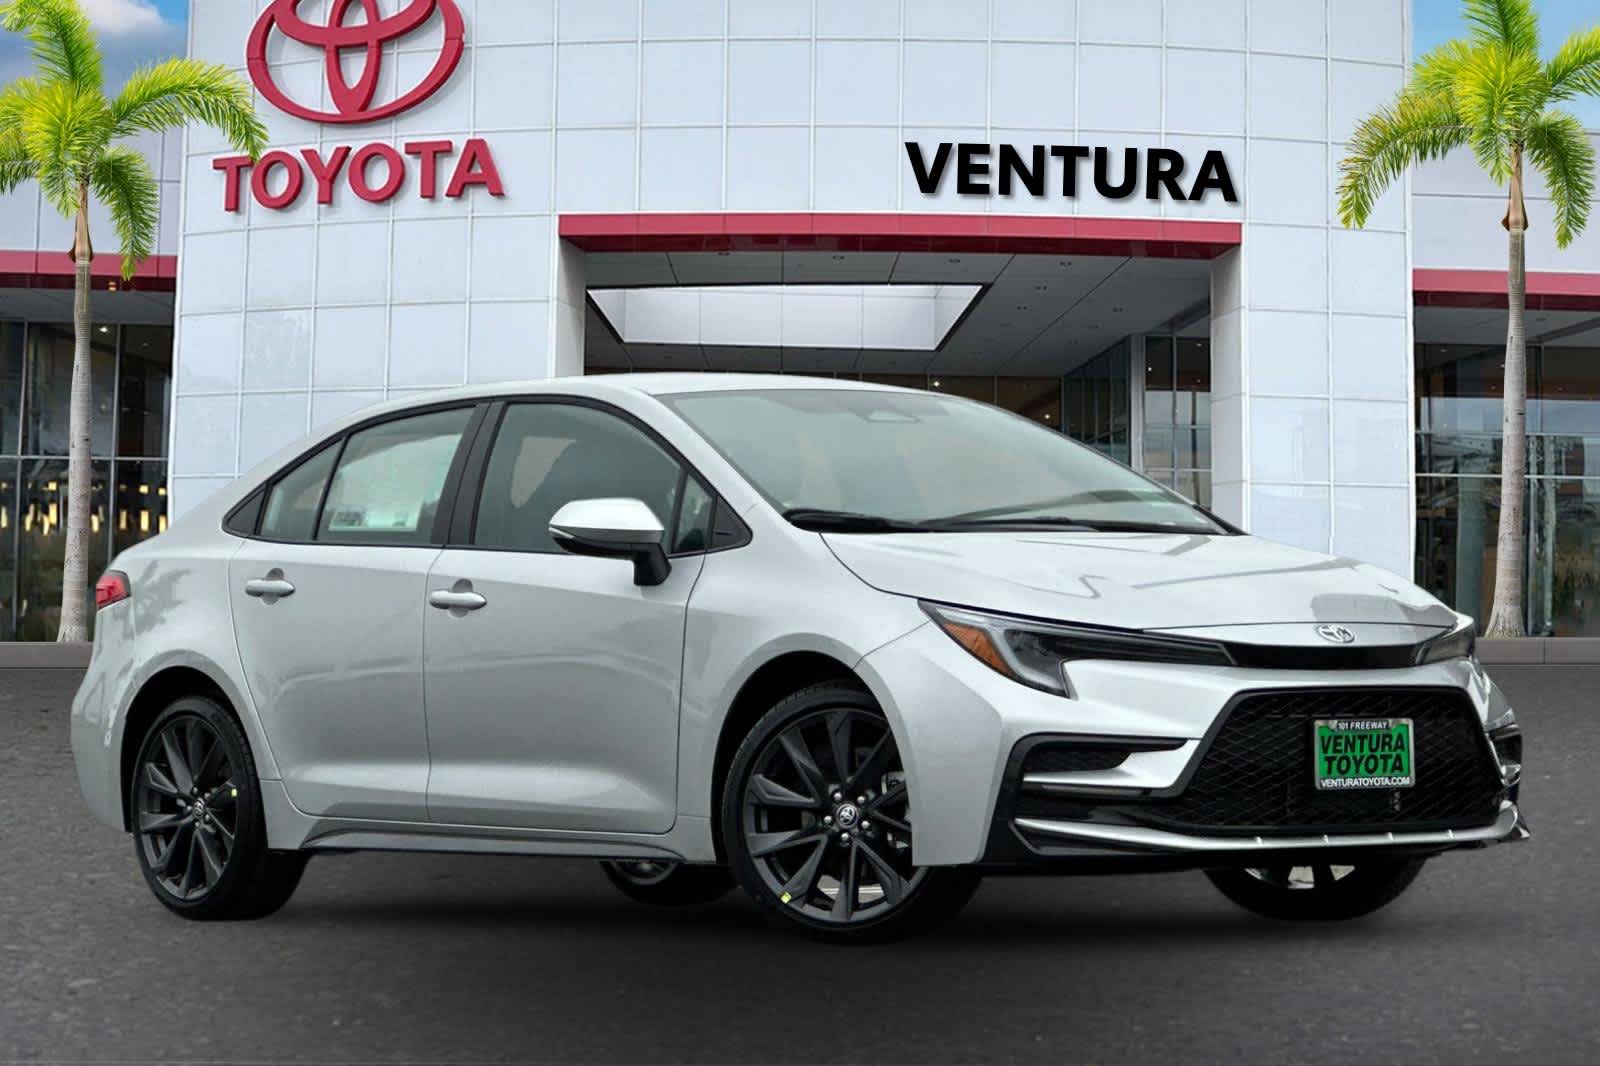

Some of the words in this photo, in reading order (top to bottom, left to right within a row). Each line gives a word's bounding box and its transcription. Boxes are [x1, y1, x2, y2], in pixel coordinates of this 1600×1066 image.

[212, 138, 505, 213] TOYOTA
[904, 141, 1238, 203] VENTURA
[1350, 721, 1388, 730] FREEWAY
[1321, 733, 1405, 754] VENTURA
[1324, 754, 1404, 775] TOYOTA
[1320, 776, 1410, 788] VENTURATOYOTA.COM
